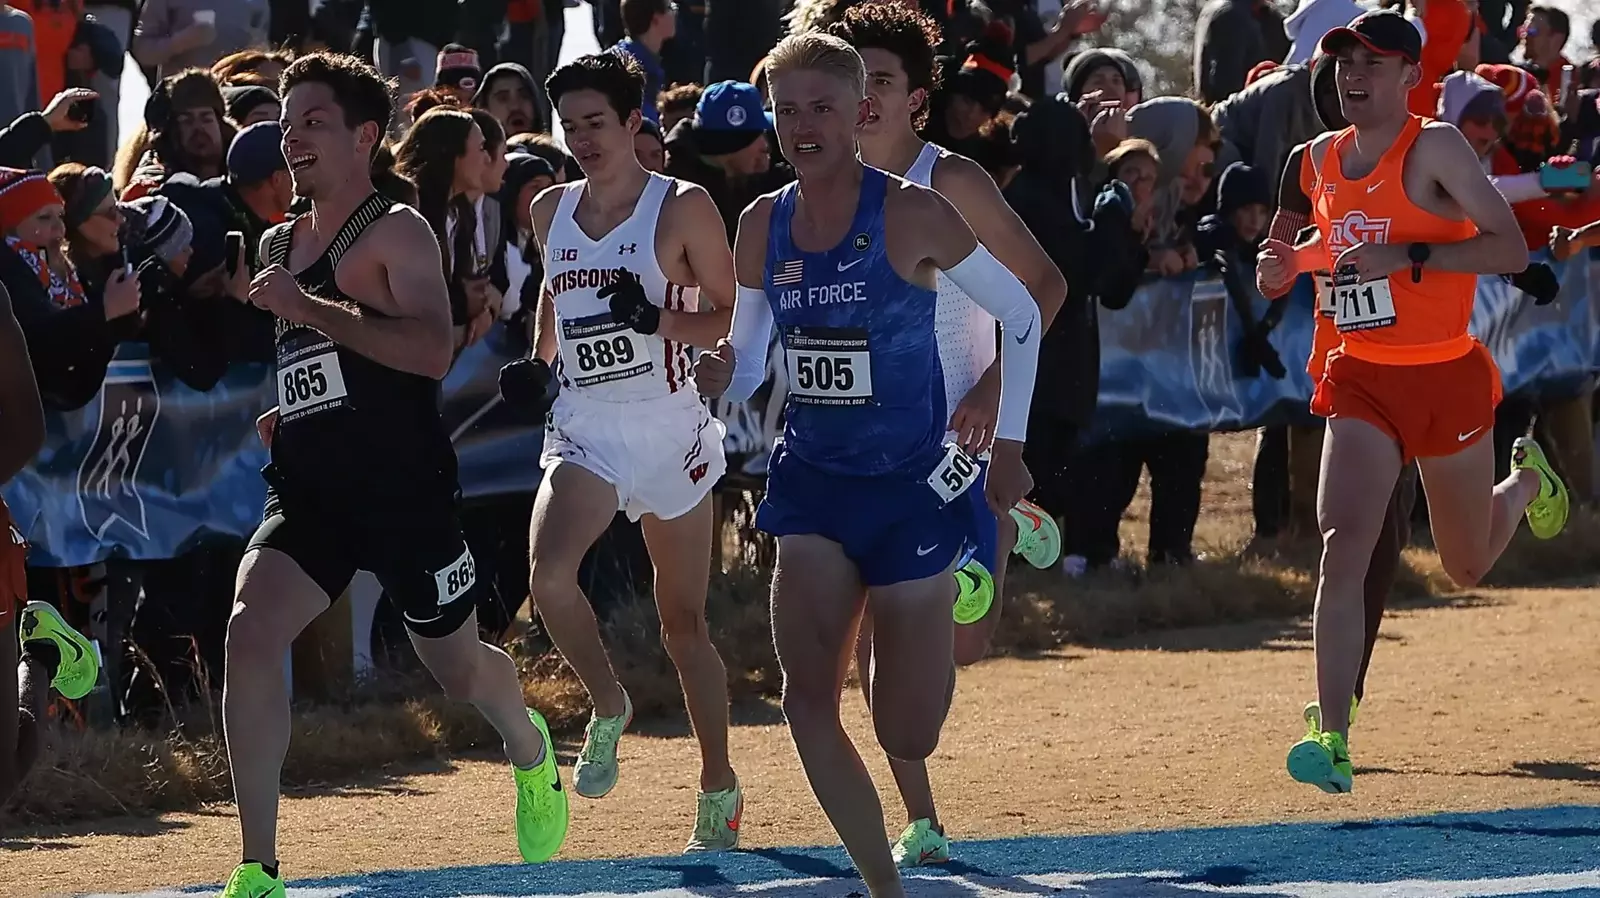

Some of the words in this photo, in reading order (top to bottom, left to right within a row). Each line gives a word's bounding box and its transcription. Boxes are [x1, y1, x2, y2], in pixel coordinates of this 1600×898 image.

[856, 238, 868, 247] RL
[780, 290, 802, 311] AIR
[808, 282, 867, 307] FORCE
[1340, 286, 1377, 319] 711
[583, 325, 601, 333] COUNTRY
[300, 341, 334, 356] CHAMPIONSHIPS
[576, 335, 635, 372] 889
[807, 338, 827, 346] COUNTRY
[827, 339, 868, 347] CHAMPIONSHIPS
[284, 362, 328, 407] 865
[797, 355, 854, 391] 505
[690, 461, 710, 485] W
